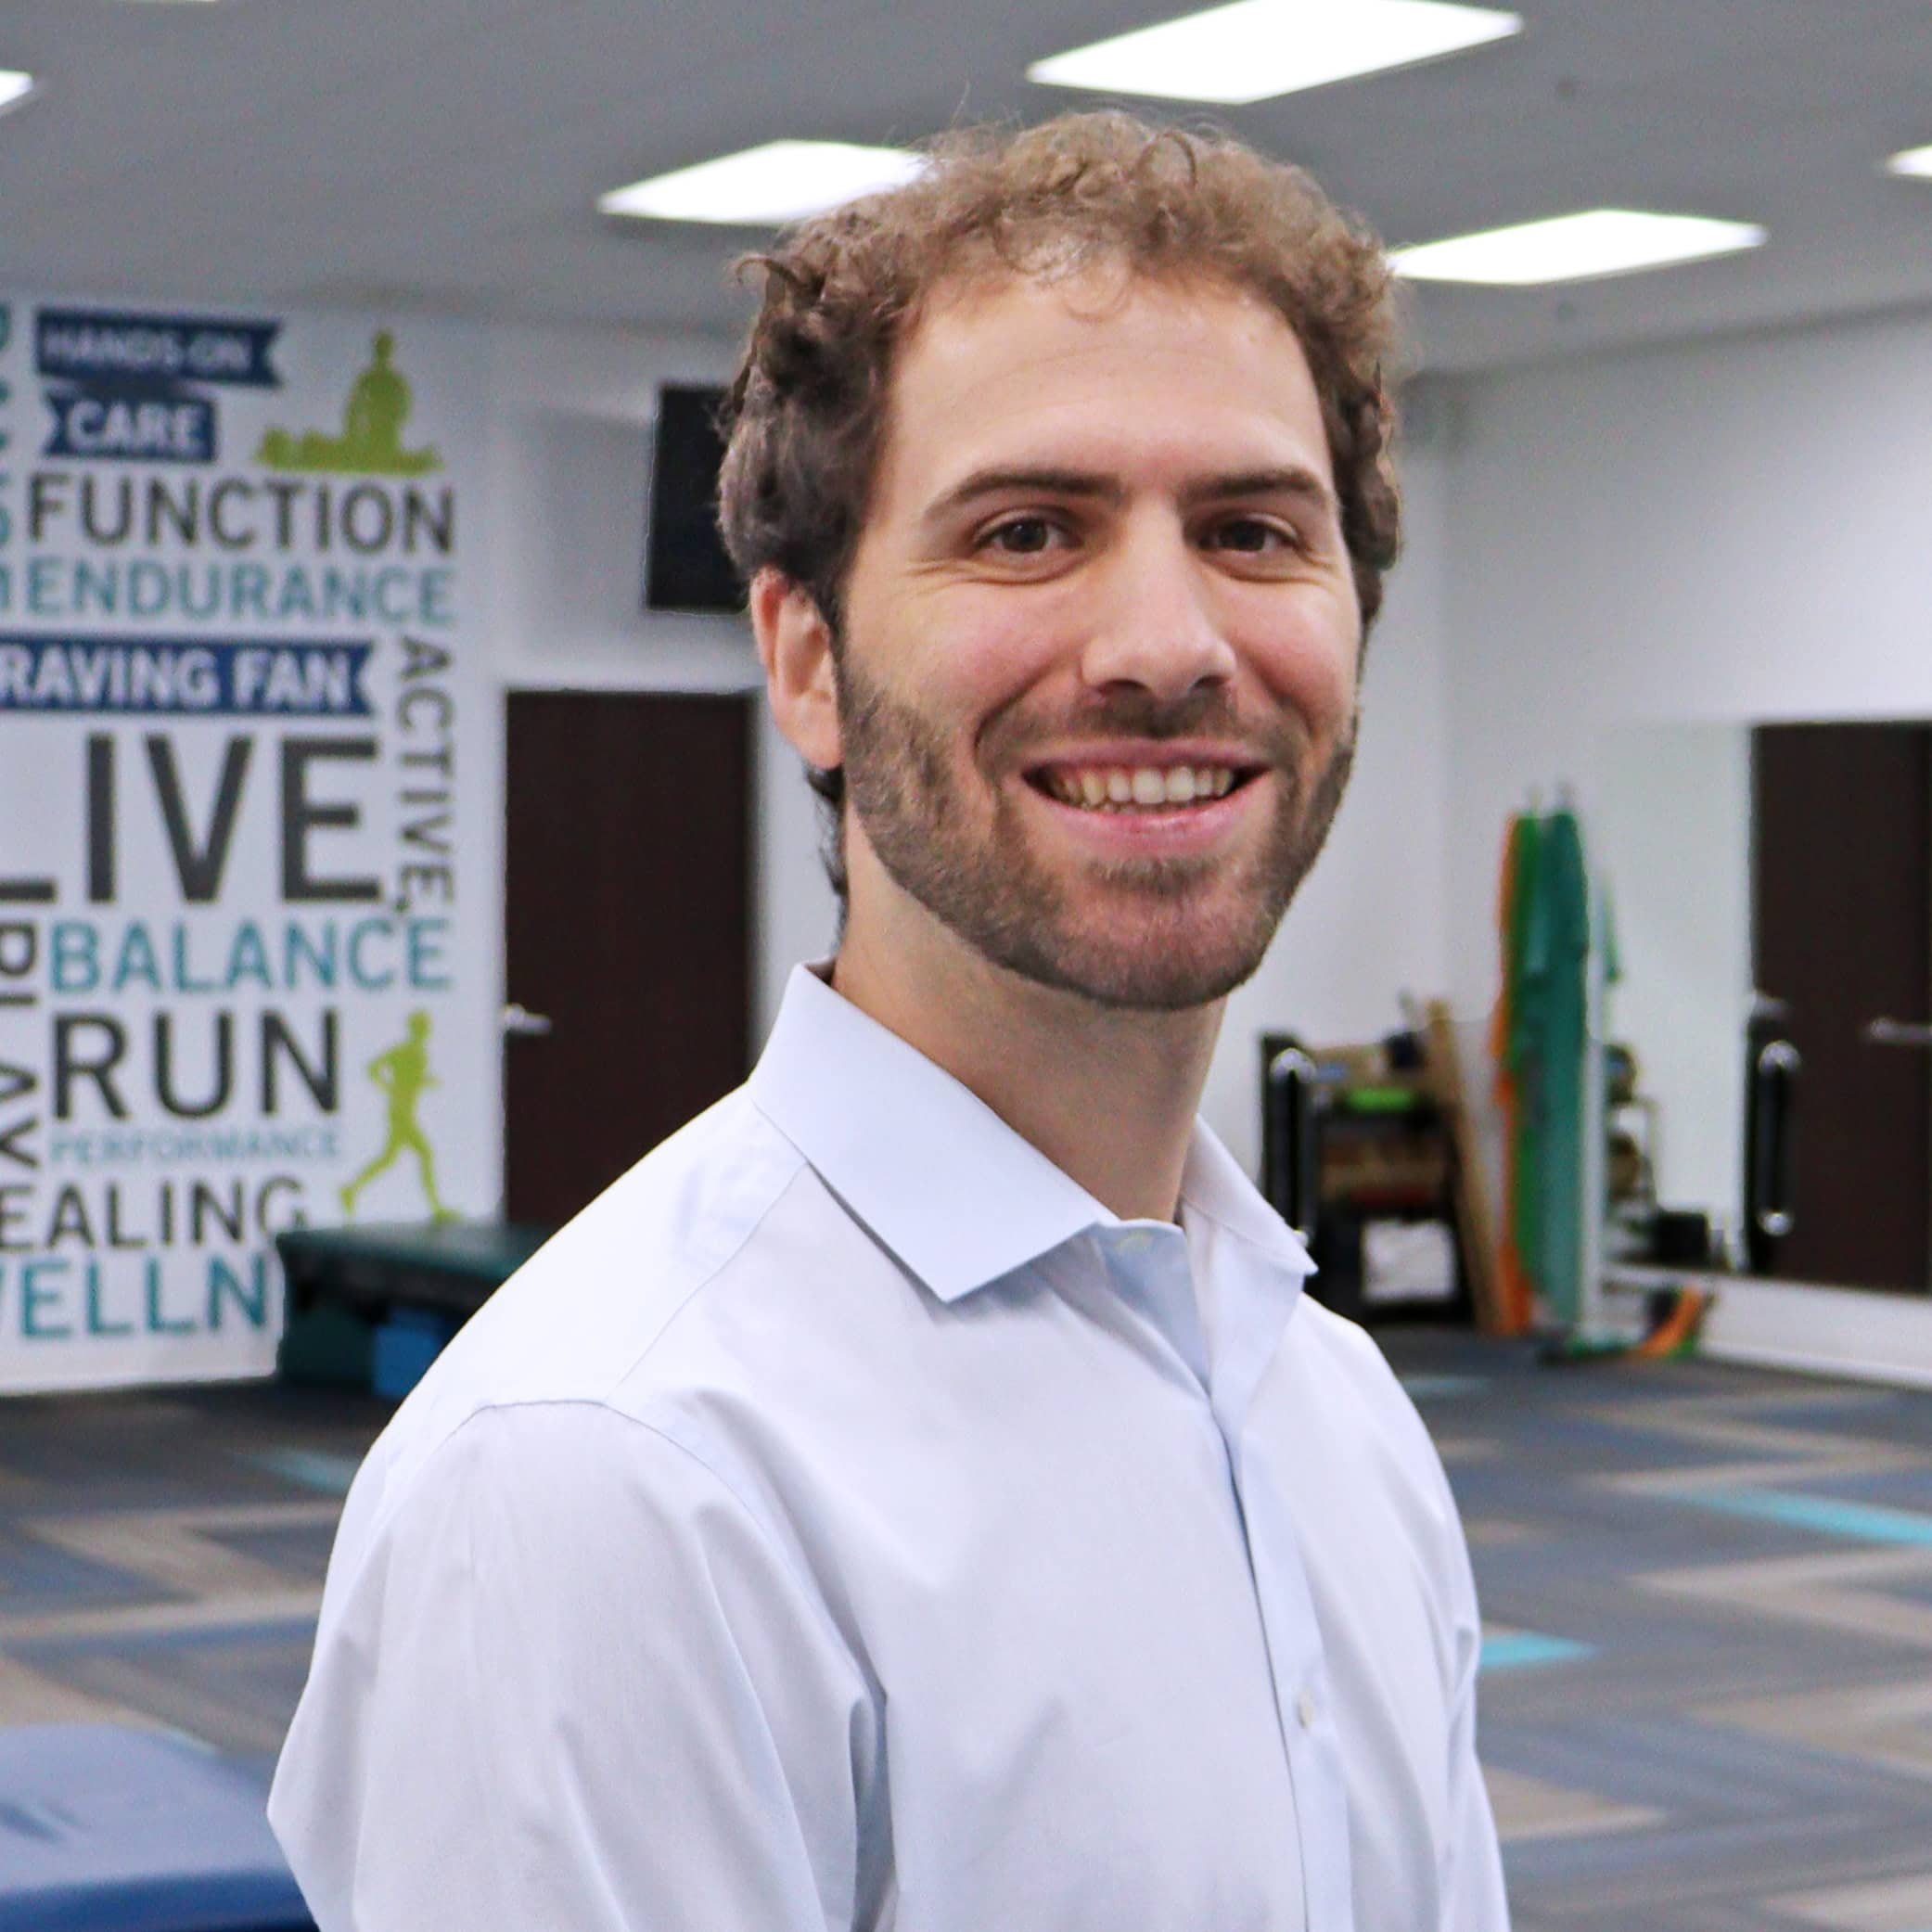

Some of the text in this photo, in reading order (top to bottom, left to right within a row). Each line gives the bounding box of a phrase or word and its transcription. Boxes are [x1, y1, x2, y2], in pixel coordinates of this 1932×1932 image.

[67, 400, 206, 453] CARE
[30, 472, 454, 555] FUNCTION
[27, 557, 455, 628] ENDURANCE
[234, 651, 351, 709] FAN
[50, 918, 452, 995] BALANCE
[53, 1010, 339, 1121] RUN
[0, 1254, 268, 1337] ELLN
